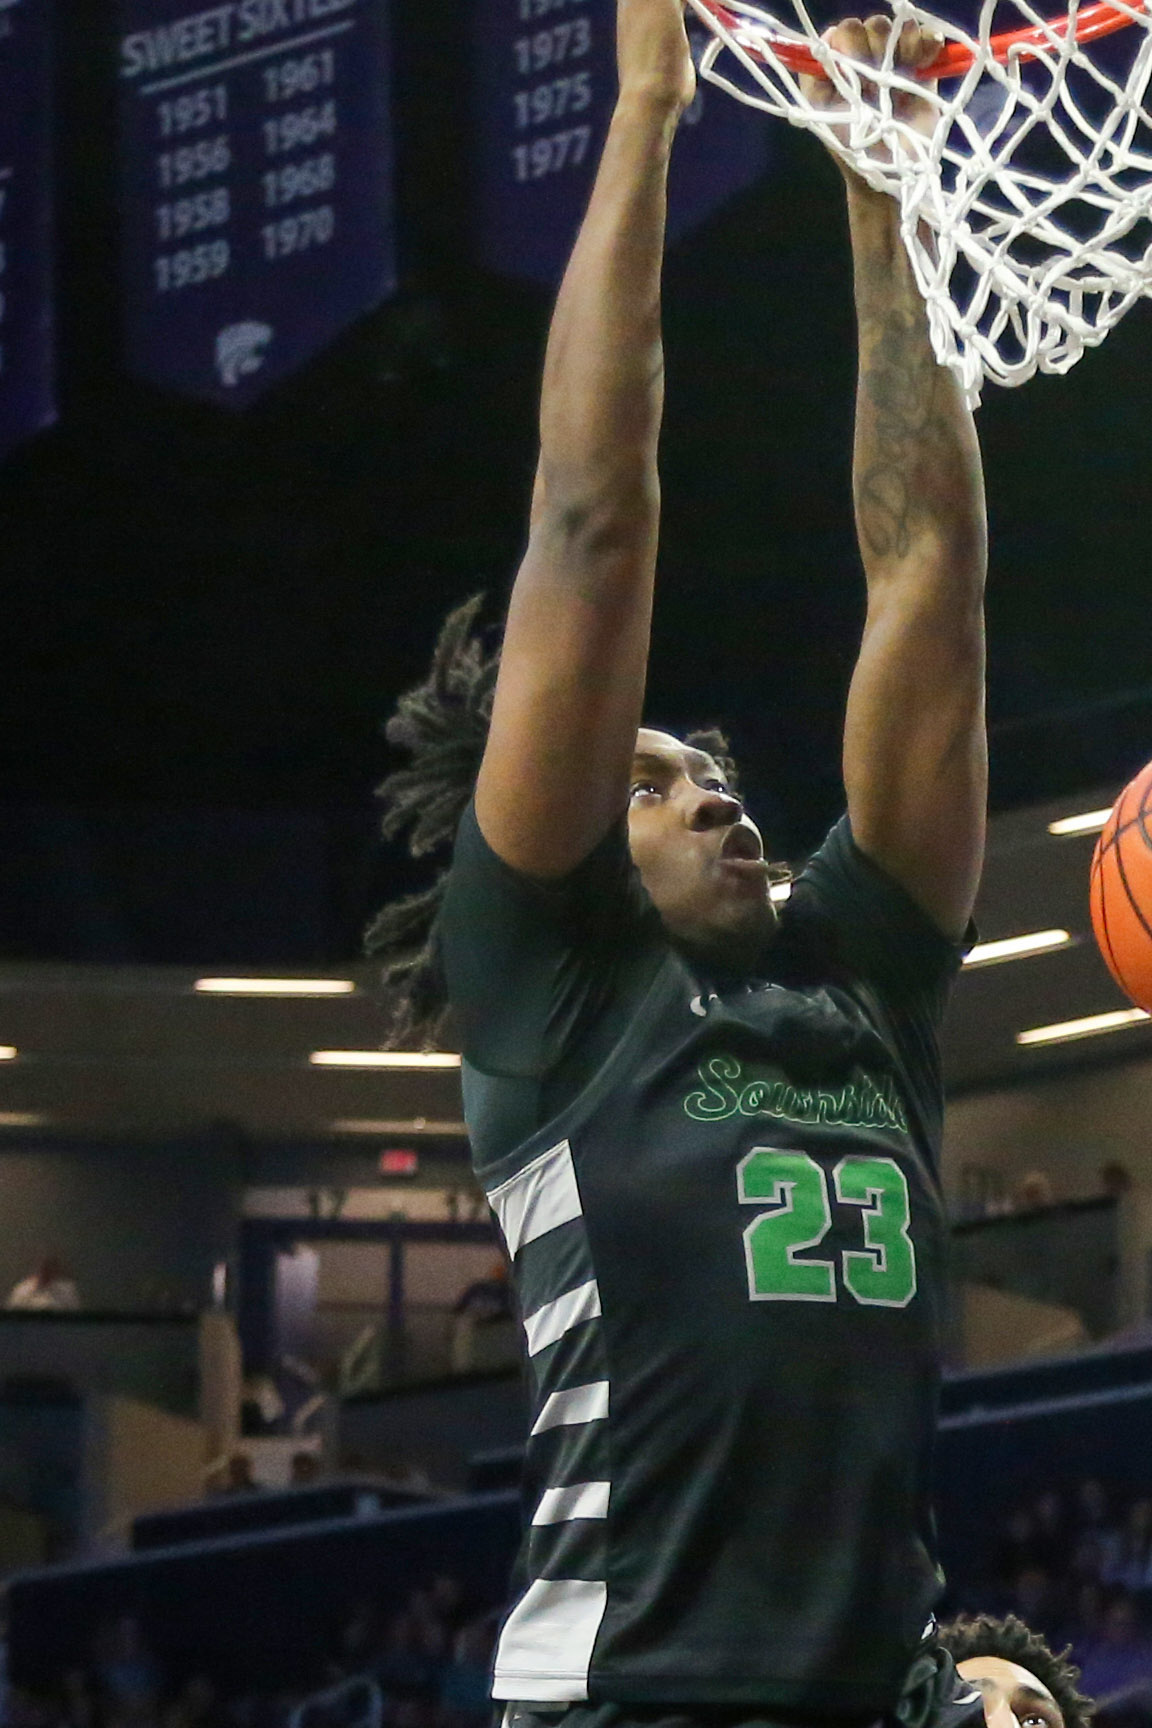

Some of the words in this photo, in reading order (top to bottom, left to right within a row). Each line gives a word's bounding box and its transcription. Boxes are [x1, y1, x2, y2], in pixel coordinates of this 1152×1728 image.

[121, 3, 235, 78] SWEET
[514, 17, 590, 74] 1973
[263, 49, 335, 101] 1961
[513, 71, 592, 128] 1975
[157, 82, 228, 136] 1951
[262, 99, 337, 155] 1964
[511, 123, 592, 182] 1977
[261, 203, 336, 260] 1970
[736, 1146, 917, 1308] 23
